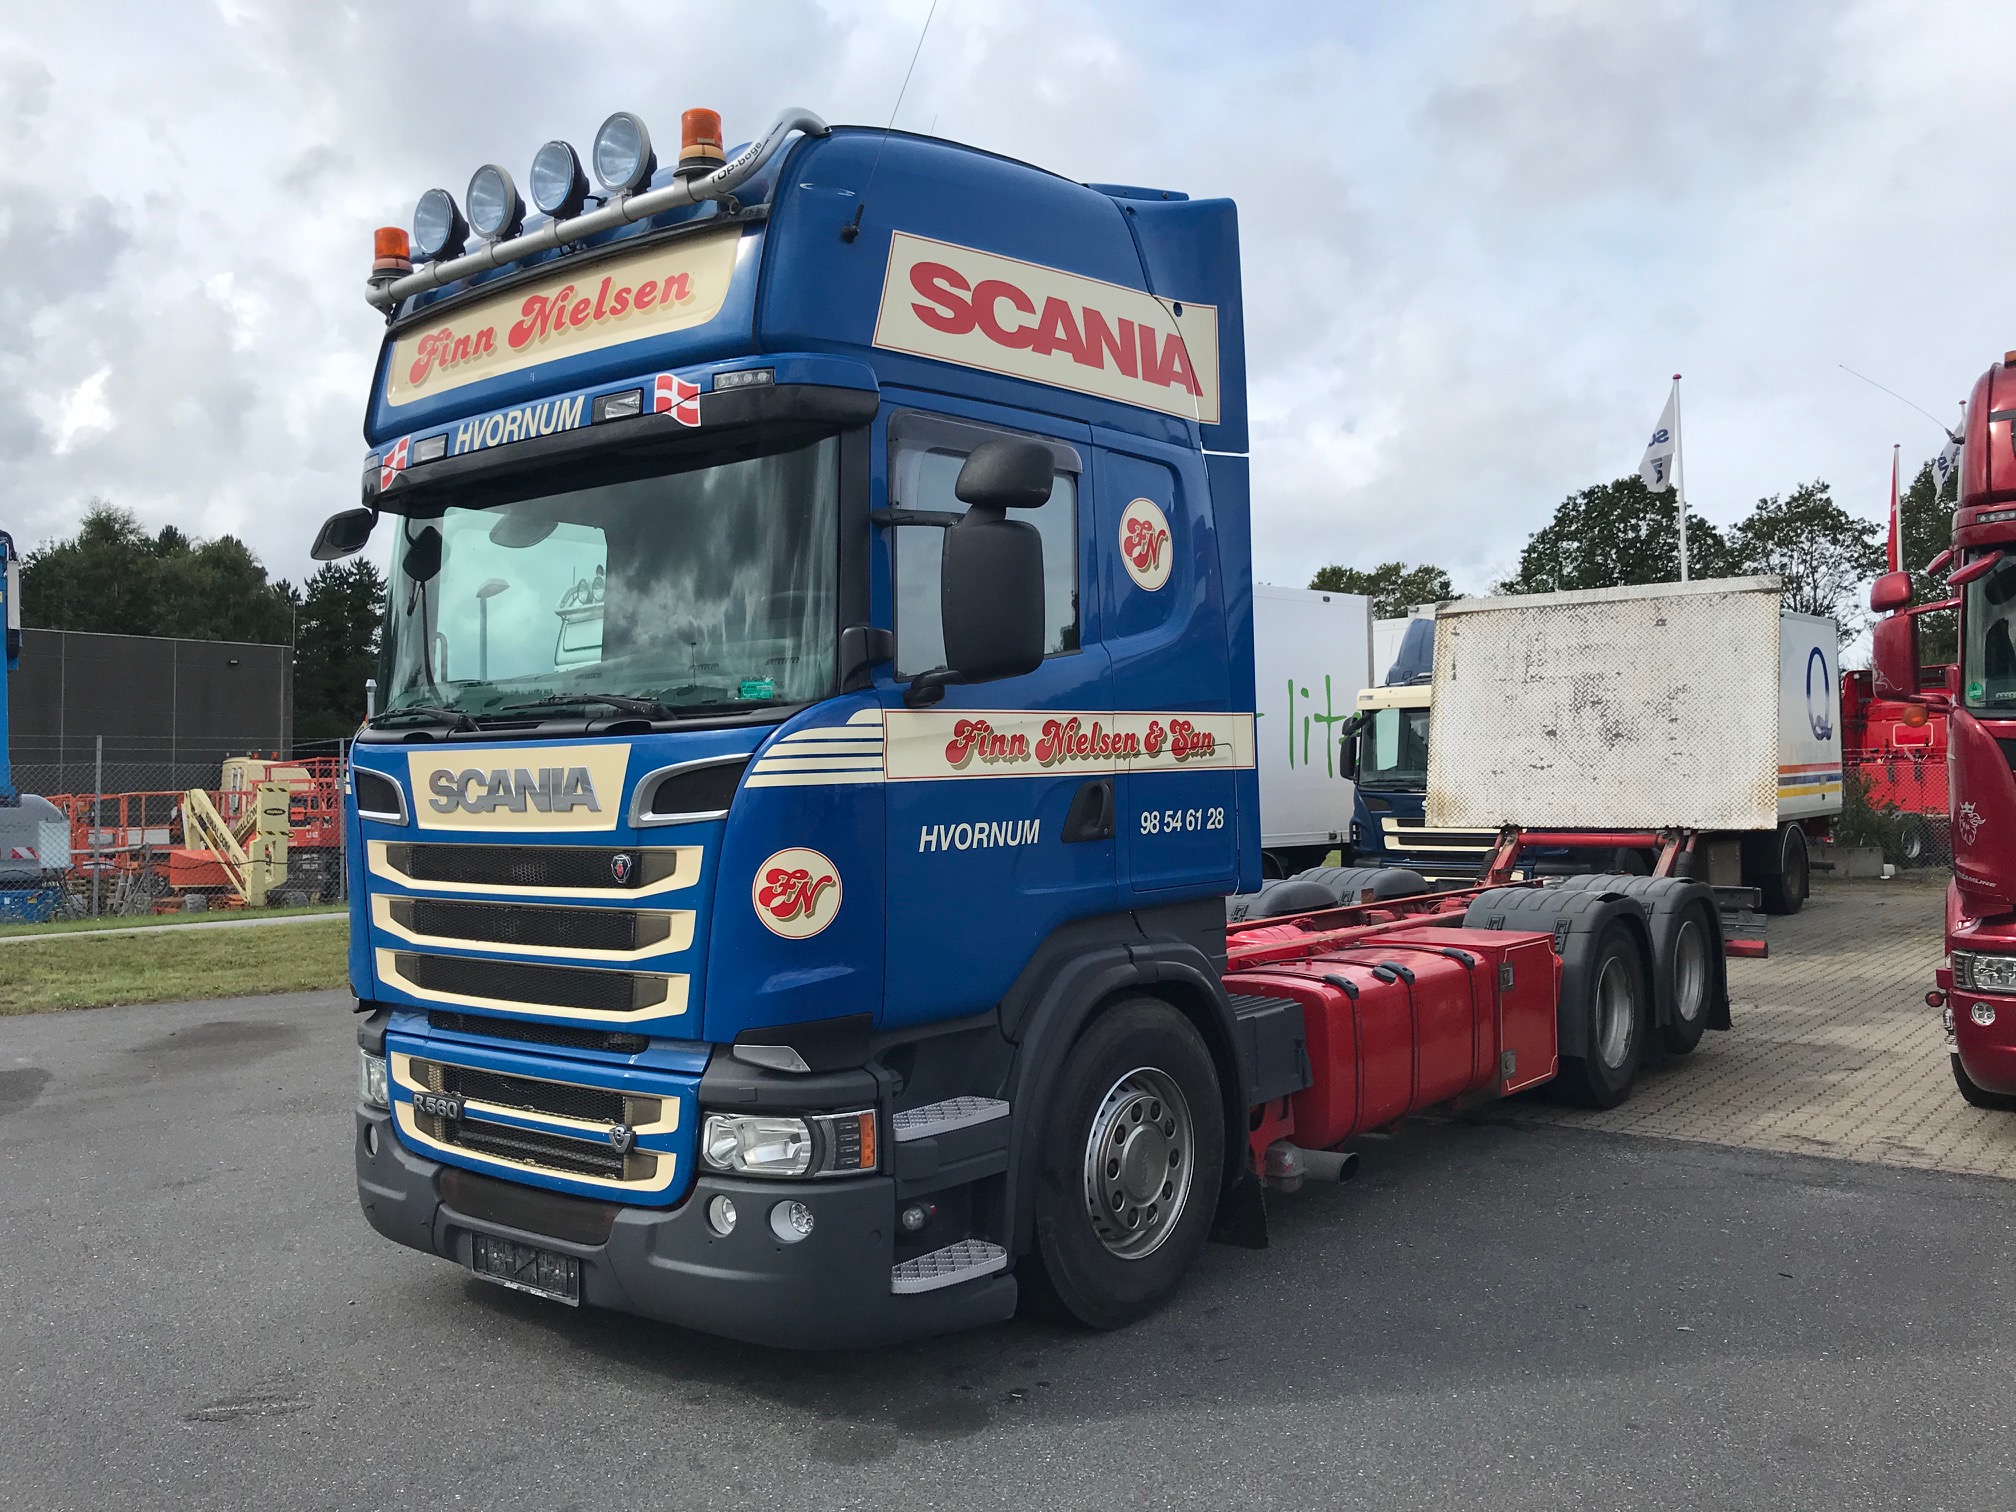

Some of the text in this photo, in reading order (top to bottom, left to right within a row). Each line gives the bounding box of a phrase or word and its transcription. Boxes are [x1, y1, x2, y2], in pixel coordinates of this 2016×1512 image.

[409, 271, 693, 385] Finn Nielsen
[908, 261, 1204, 398] SCANIA
[454, 395, 585, 456] HVORNUM
[945, 719, 1030, 770] Finn
[1035, 716, 1140, 769] Nielsen
[1144, 720, 1168, 759] &
[1287, 674, 1361, 779] lit
[428, 766, 603, 814] SCANIA
[918, 818, 1041, 853] HVORNUM
[1140, 807, 1225, 836] 98 54 61 28
